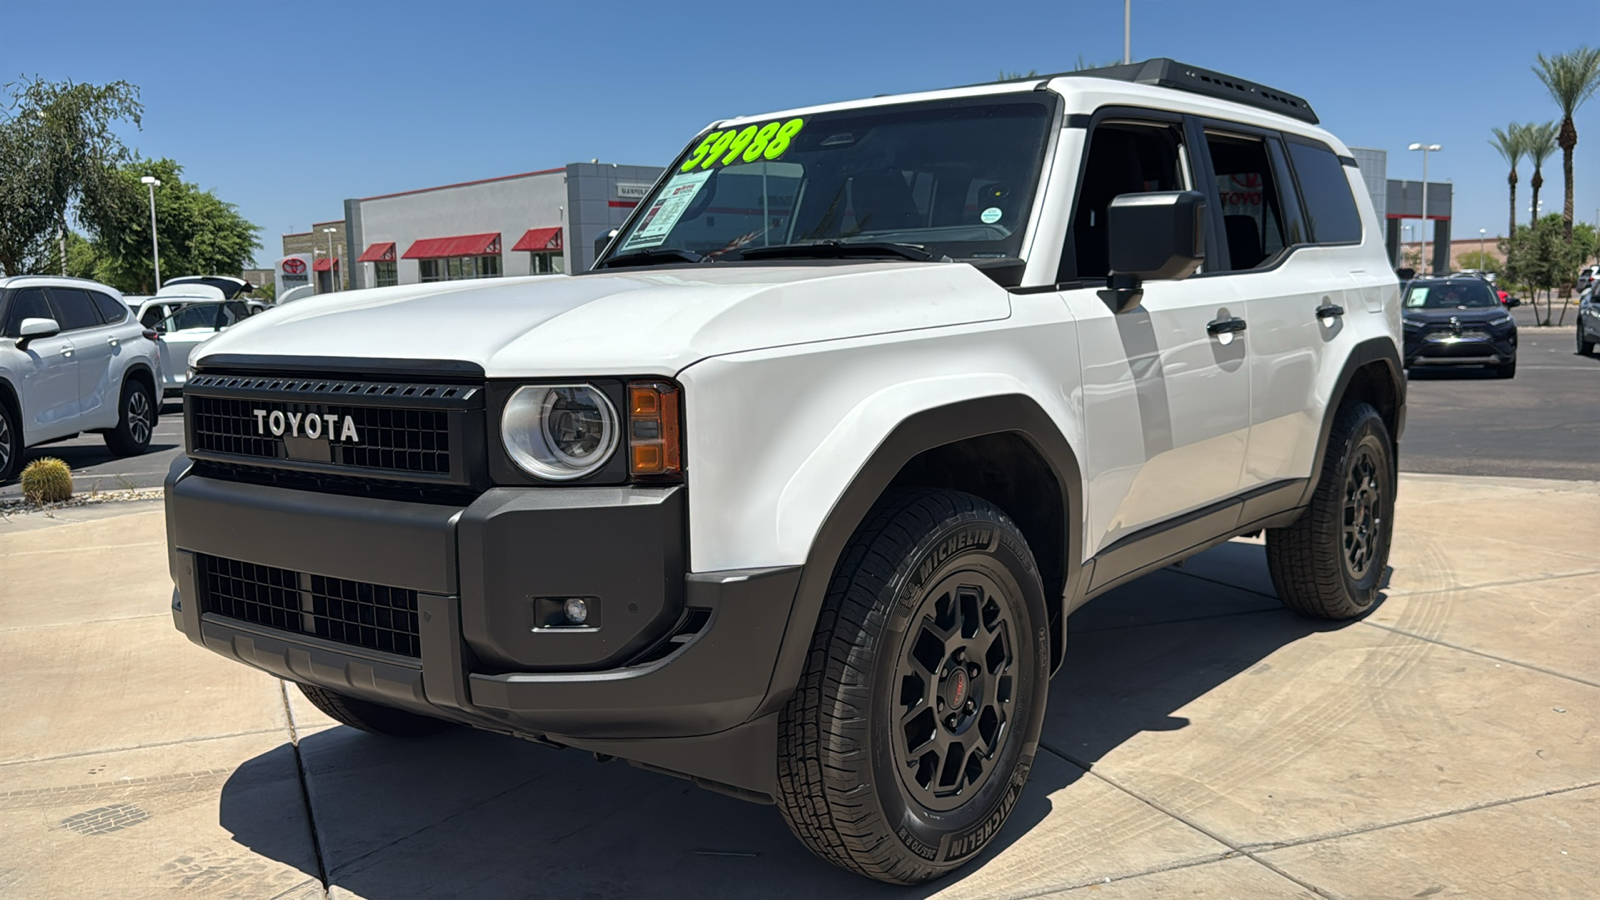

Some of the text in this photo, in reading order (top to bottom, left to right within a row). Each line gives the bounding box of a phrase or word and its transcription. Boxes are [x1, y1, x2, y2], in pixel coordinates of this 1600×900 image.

[681, 118, 804, 172] 59988
[253, 409, 359, 442] TOYOTA
[920, 528, 991, 583] MICHELIN
[953, 673, 963, 705] TRD
[898, 828, 937, 859] 265/70 R 18
[949, 787, 1016, 857] MICHELIN
